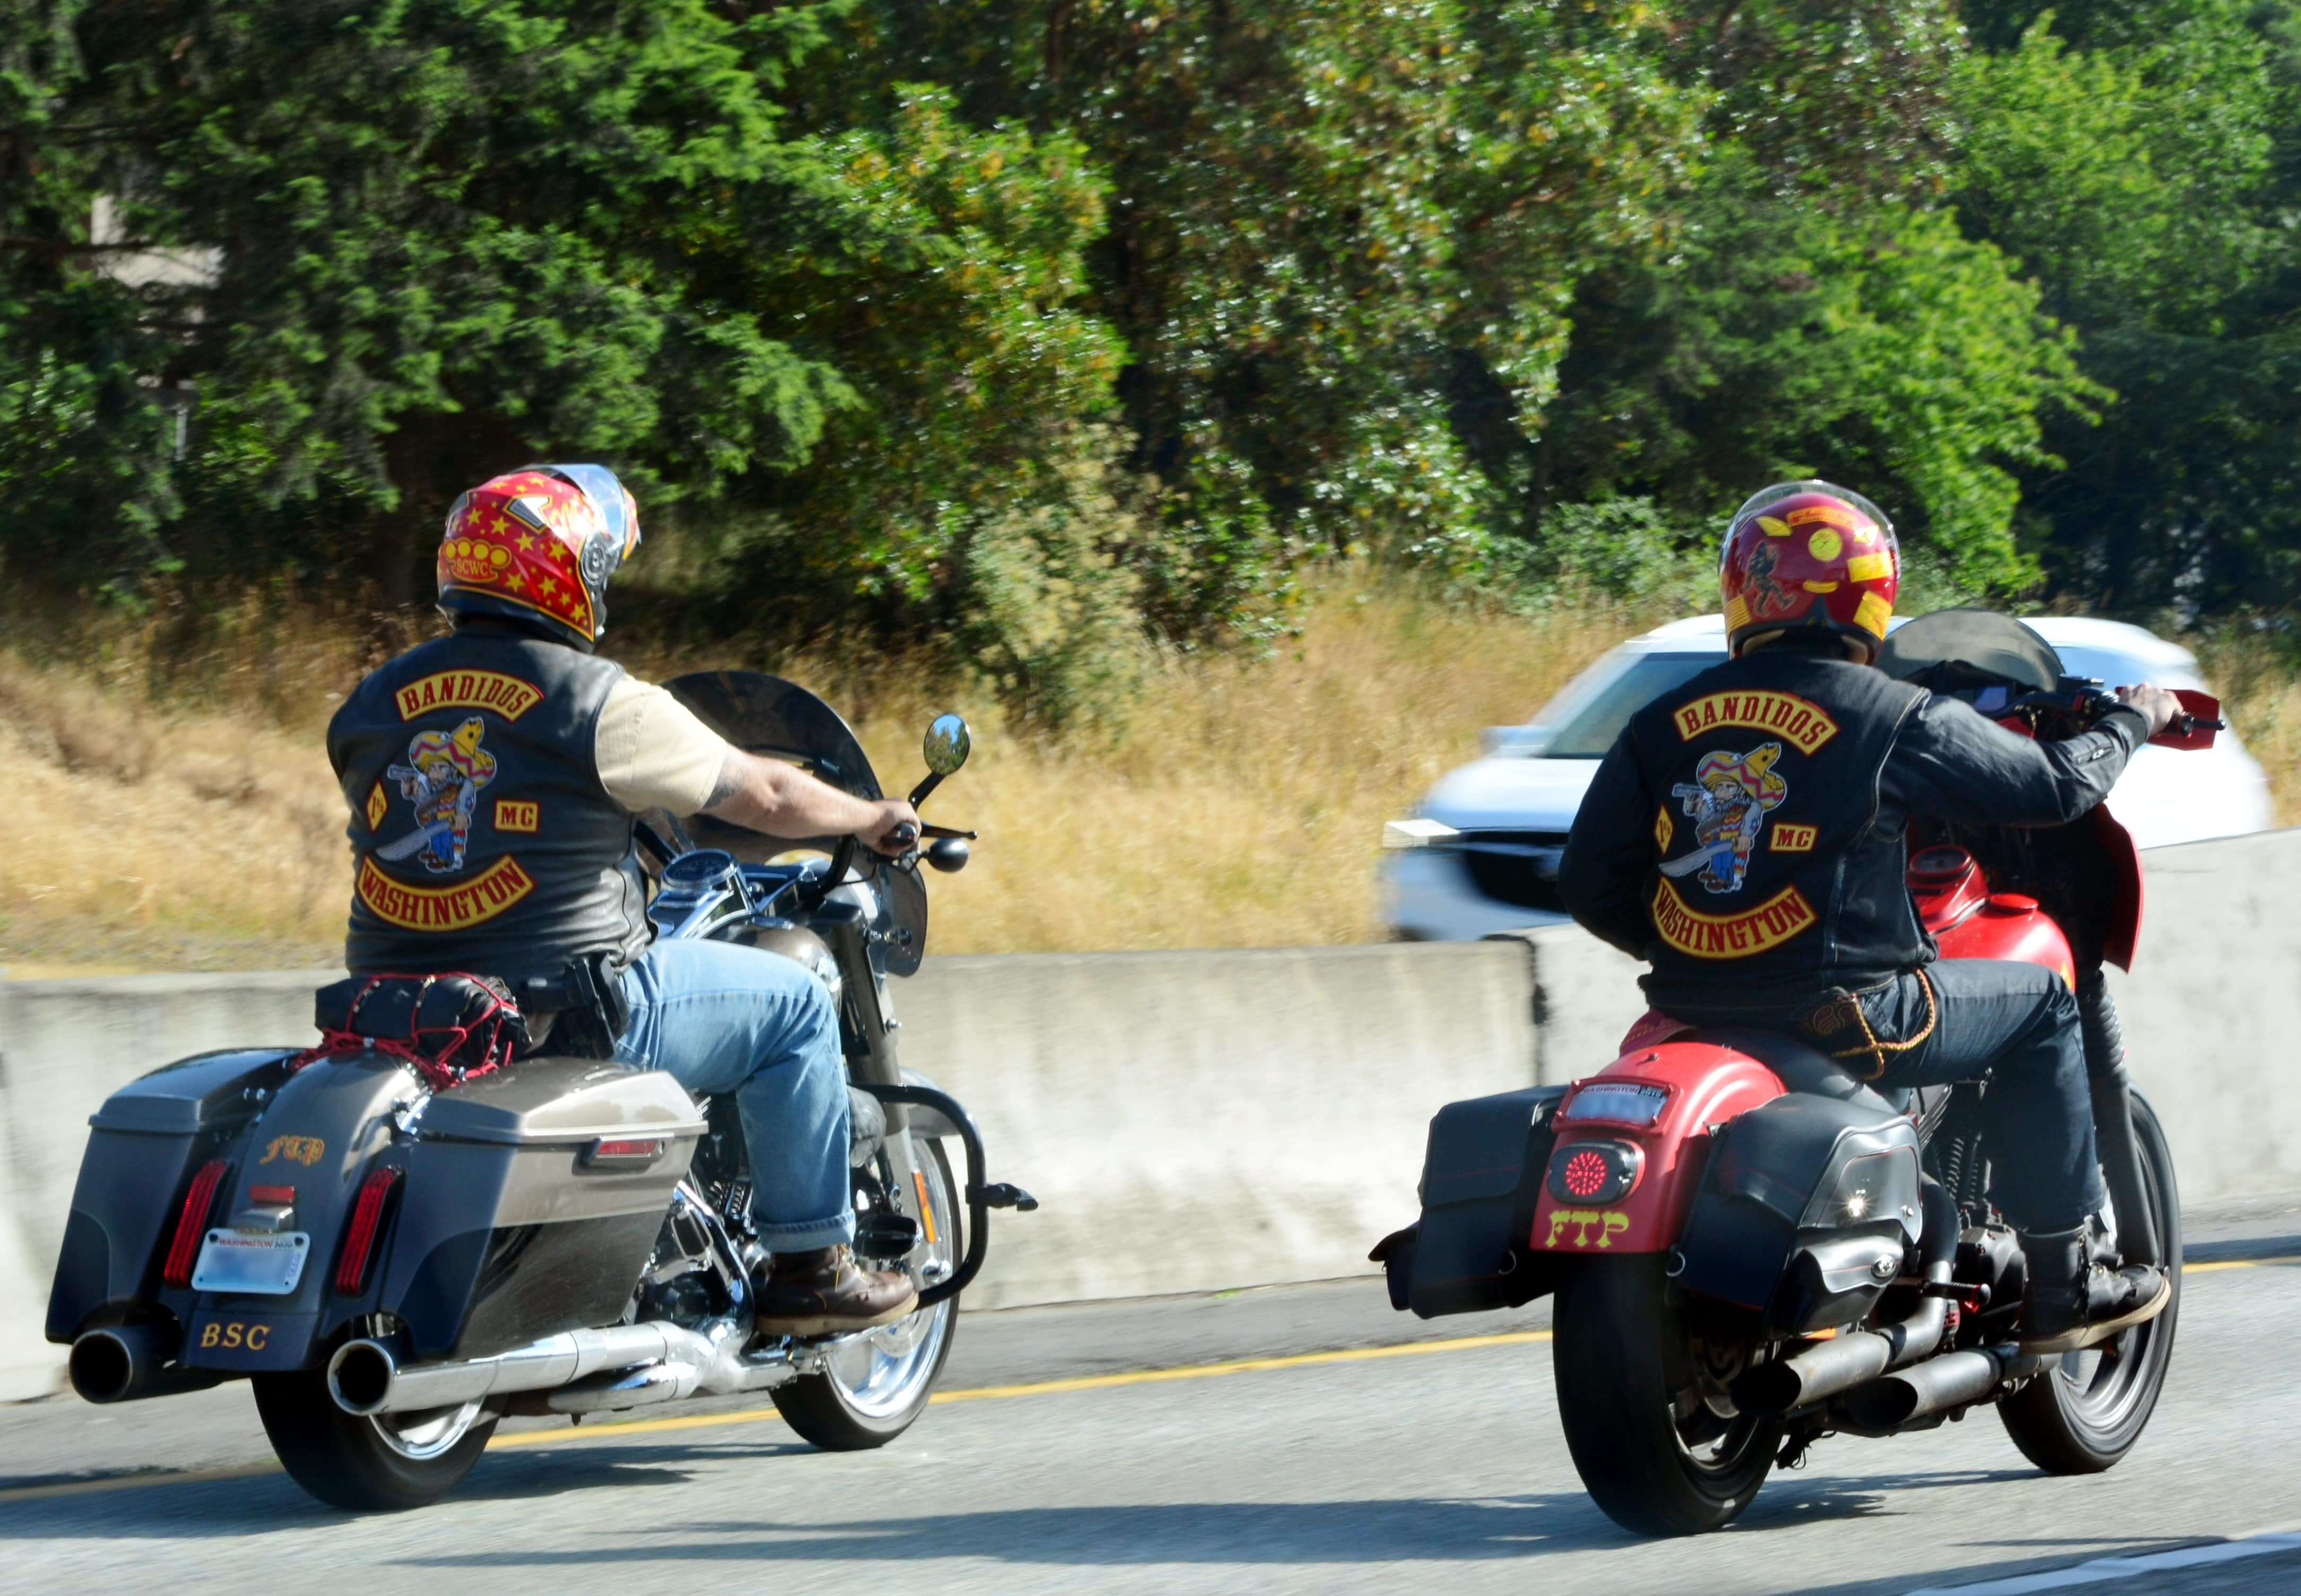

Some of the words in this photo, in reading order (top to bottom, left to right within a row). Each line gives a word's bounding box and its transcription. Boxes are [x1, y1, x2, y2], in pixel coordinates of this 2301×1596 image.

[402, 674, 531, 715] BANDIDOS
[1682, 696, 1828, 747] BANDIDOS
[501, 806, 533, 826] MC
[1776, 829, 1811, 847] MC
[362, 861, 527, 924] WASHINGTON
[1656, 887, 1808, 952] WASHINGTON
[1546, 1211, 1629, 1248] FTP
[201, 1323, 271, 1350] BSC
